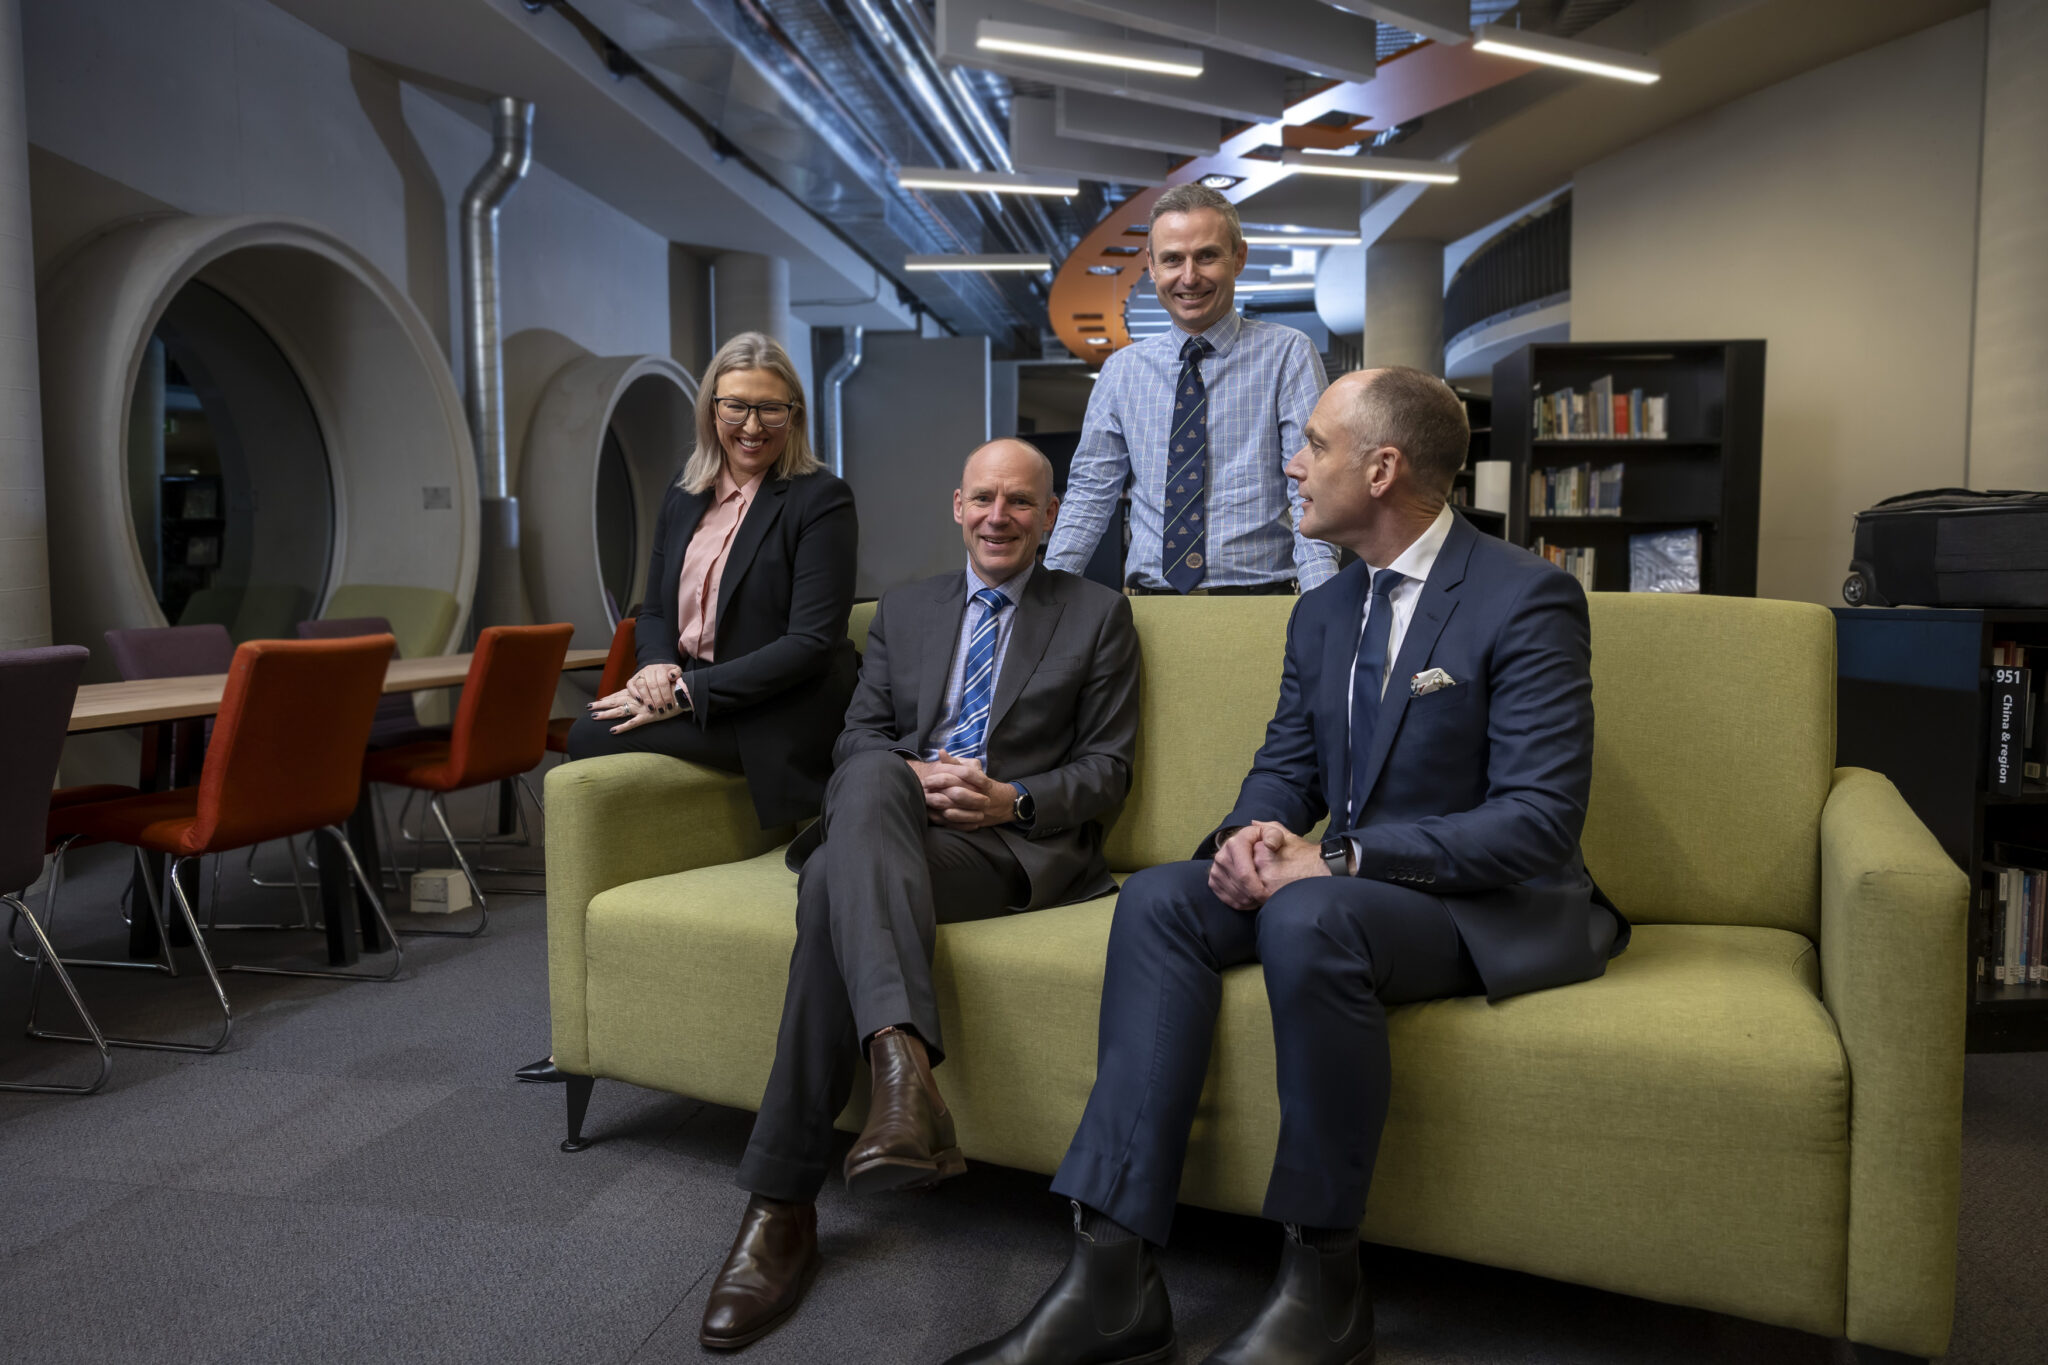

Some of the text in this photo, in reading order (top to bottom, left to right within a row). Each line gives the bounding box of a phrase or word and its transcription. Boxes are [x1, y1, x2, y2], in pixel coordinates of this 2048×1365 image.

[1996, 669, 2020, 684] 951
[1998, 694, 2012, 783] China & region
